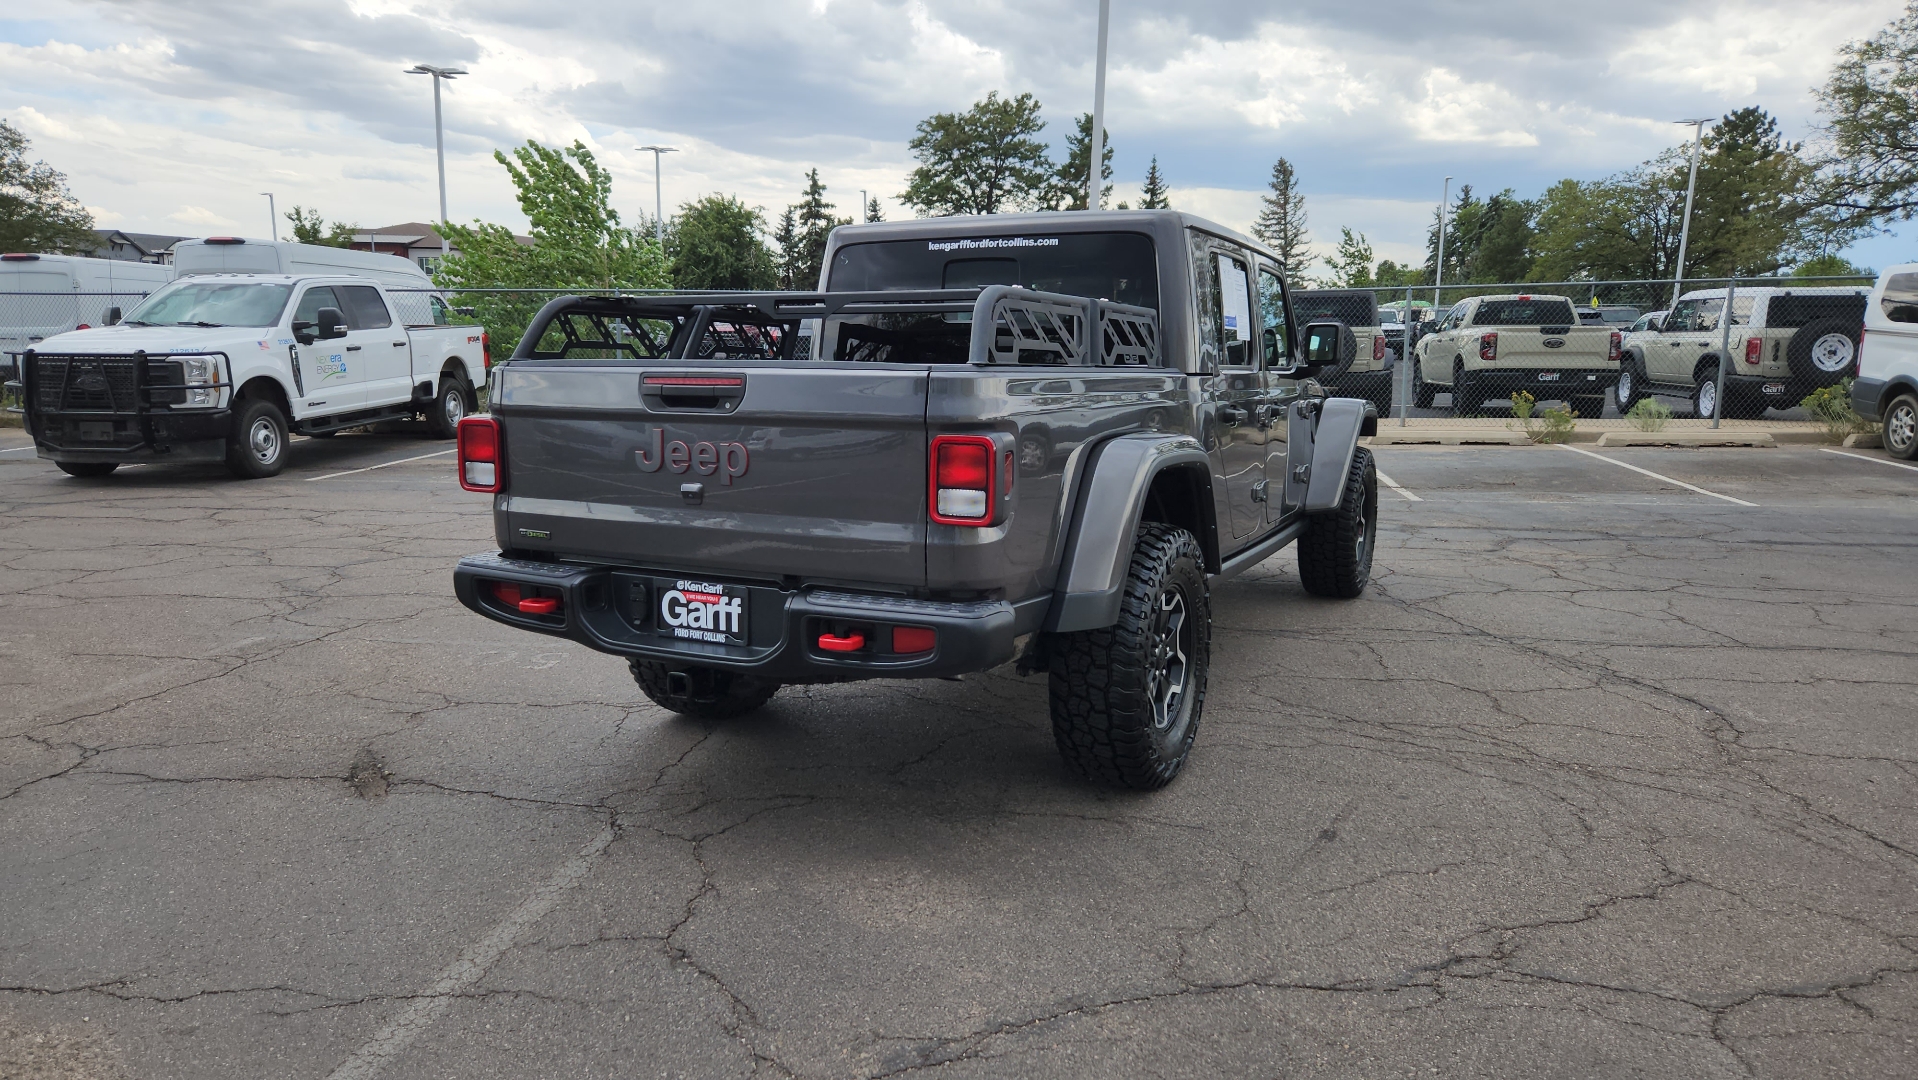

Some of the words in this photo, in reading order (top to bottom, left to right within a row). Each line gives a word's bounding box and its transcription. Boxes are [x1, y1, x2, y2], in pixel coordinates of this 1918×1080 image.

[928, 237, 1059, 251] kengarfffordfortcollins.com
[316, 364, 339, 375] ENERGY
[635, 428, 749, 486] Jeep
[662, 590, 741, 632] Garff
[675, 628, 689, 638] FORD
[690, 630, 703, 640] FORT
[703, 632, 726, 643] COLLINS
